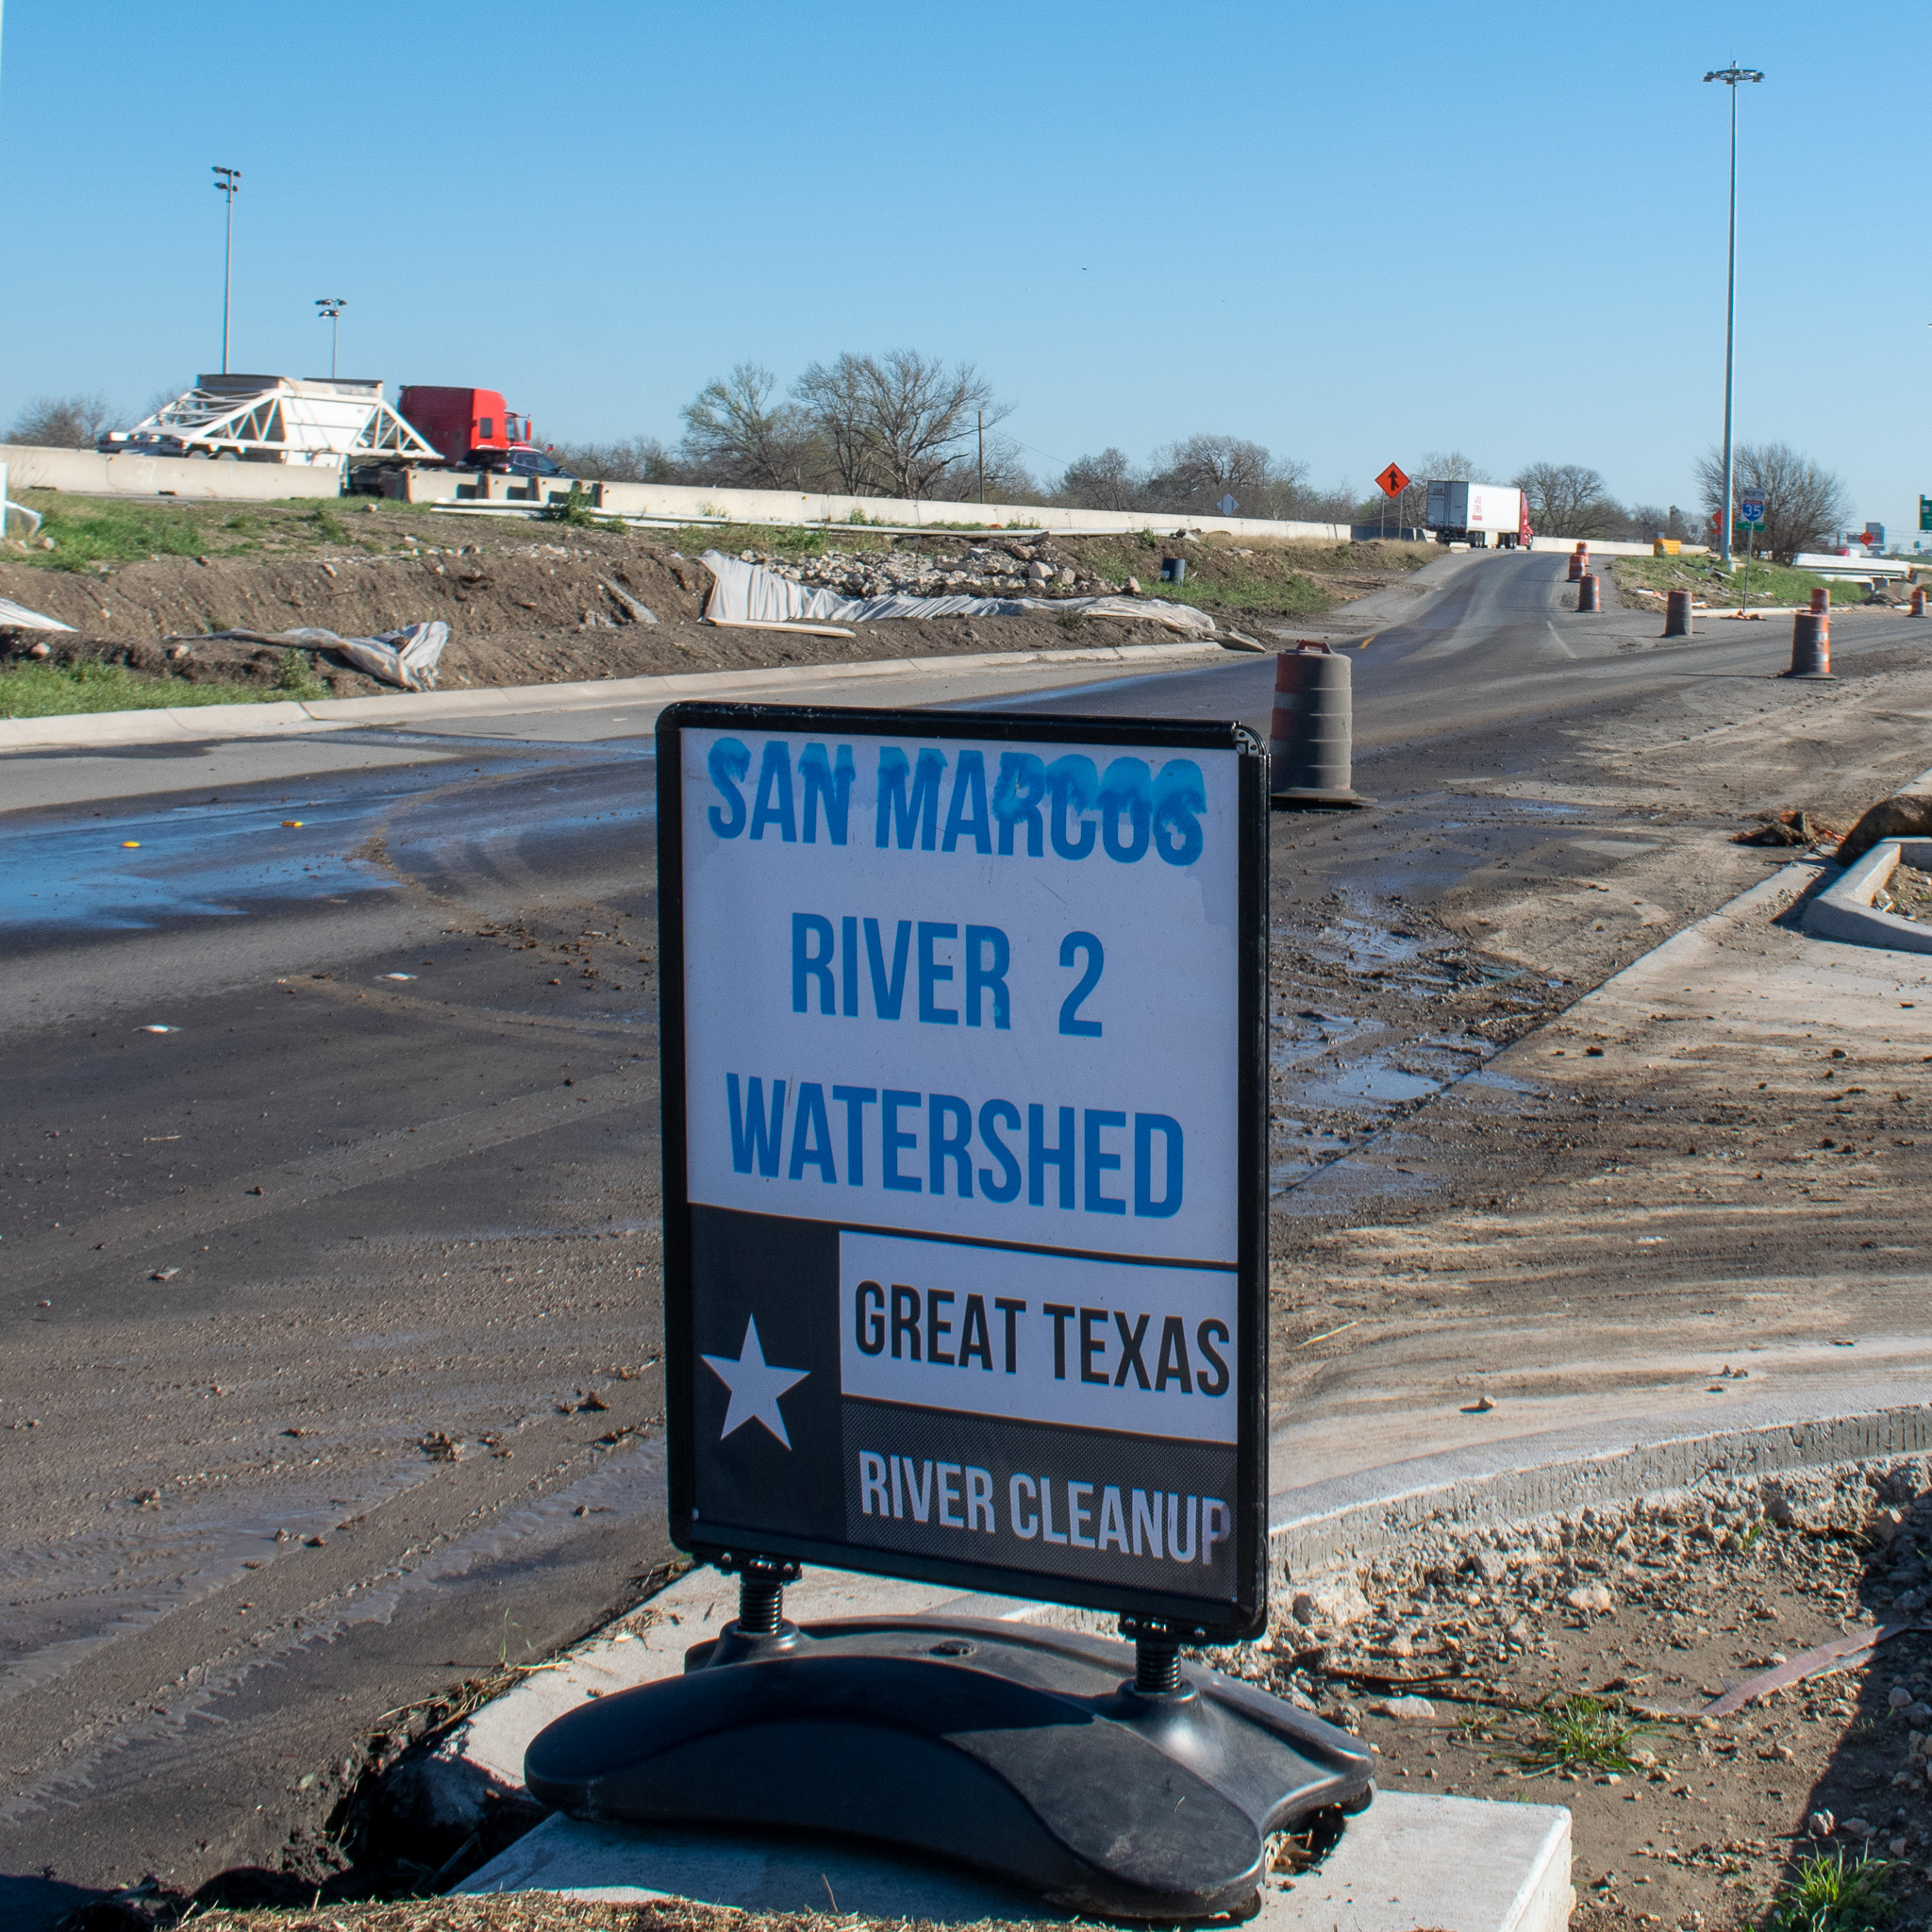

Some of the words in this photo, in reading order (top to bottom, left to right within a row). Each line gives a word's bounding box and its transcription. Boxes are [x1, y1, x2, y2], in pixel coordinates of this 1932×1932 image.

[1744, 504, 1761, 517] 35
[708, 737, 856, 846] SAN
[875, 746, 1208, 866] MARCOS
[791, 912, 1011, 1030] RIVER
[1058, 931, 1105, 1038] 2
[725, 1073, 1184, 1219] WATERSHED
[855, 1280, 1026, 1375] GREAT
[1043, 1302, 1230, 1397] TEXAS
[858, 1450, 996, 1534] RIVER
[1009, 1474, 1230, 1566] CLEANUP
